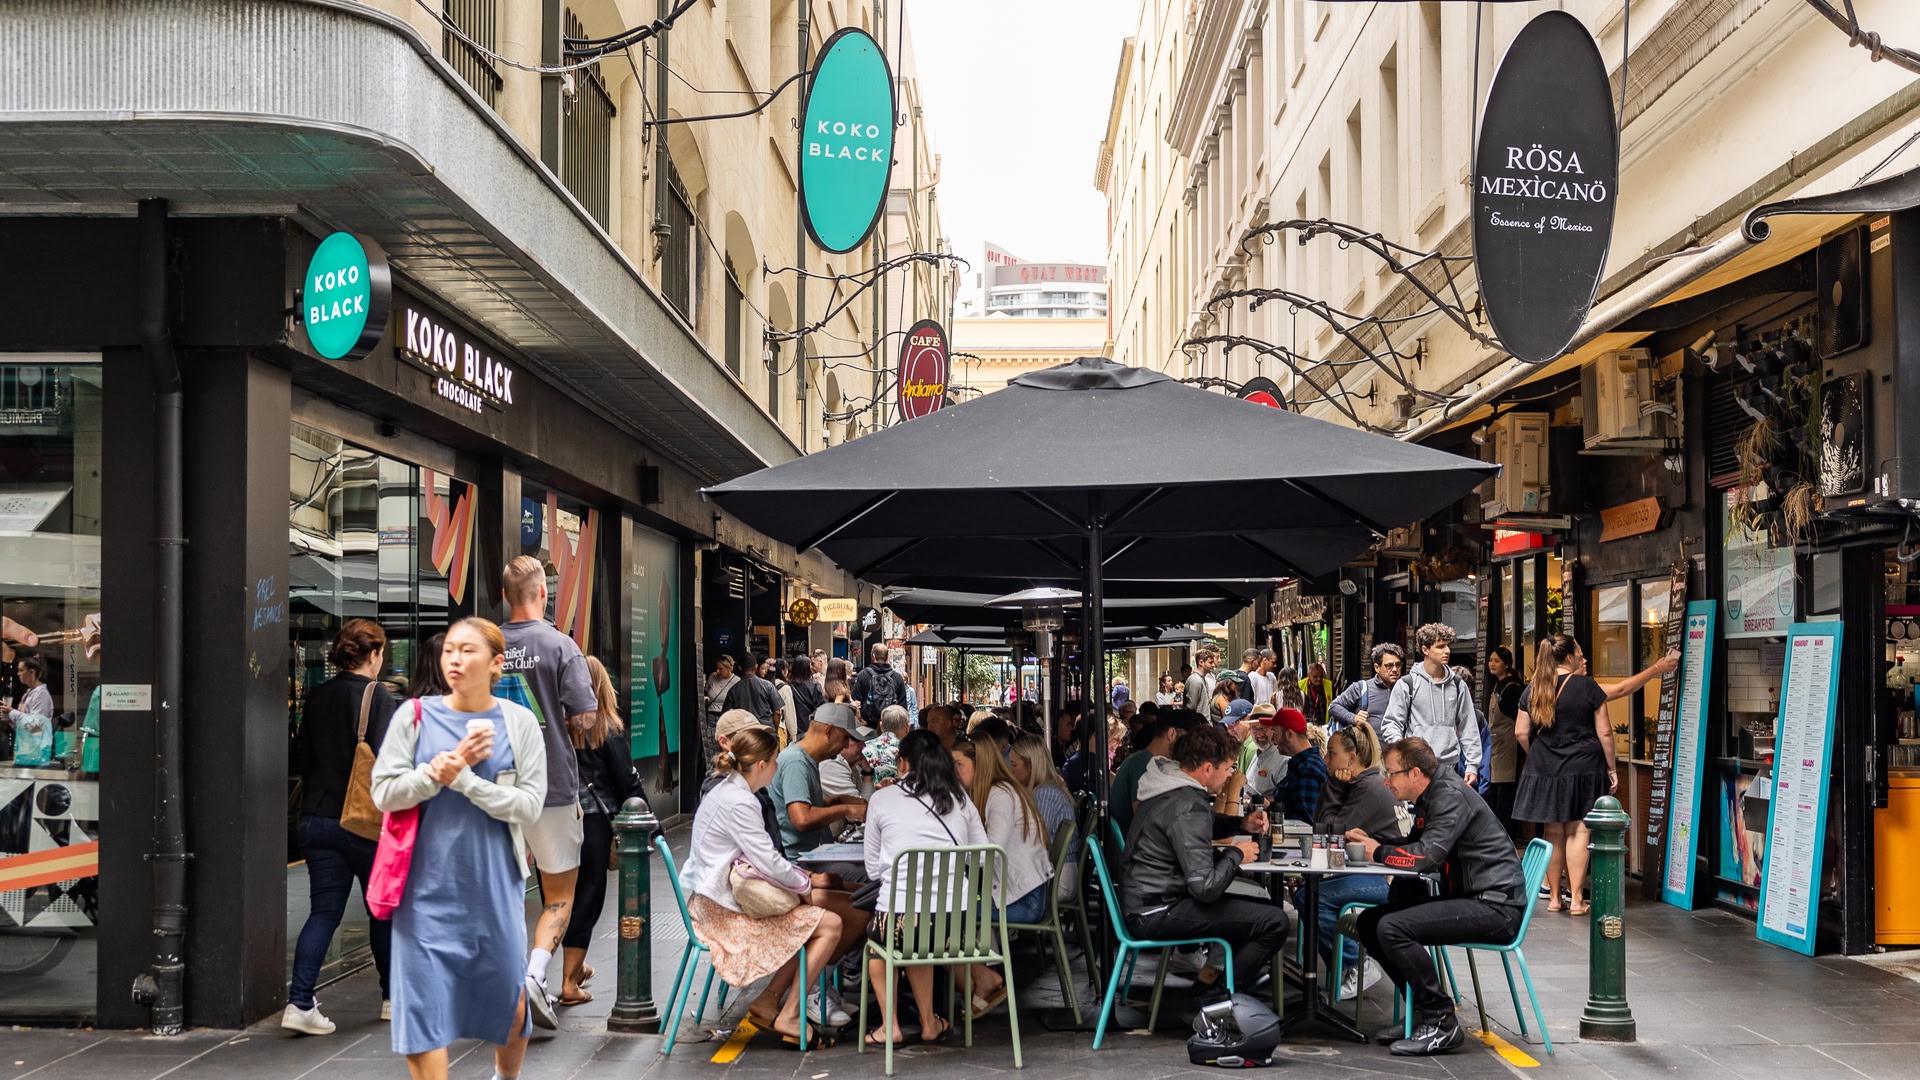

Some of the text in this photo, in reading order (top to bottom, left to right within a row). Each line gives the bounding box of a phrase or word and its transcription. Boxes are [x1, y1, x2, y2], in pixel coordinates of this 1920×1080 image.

[817, 120, 880, 139] KOKO
[809, 142, 884, 162] BLACK
[1505, 143, 1585, 175] RÖSA
[1480, 175, 1607, 203] MEXÌCANÖ
[1490, 211, 1593, 234] Essence of Mexico
[314, 265, 359, 293] KOKO
[1021, 267, 1097, 283] QUAY WEST
[310, 295, 364, 324] BLACK
[910, 333, 941, 347] CAFÉ
[406, 308, 513, 405] KOKO BLACK
[437, 377, 482, 414] CHOCOLATE
[902, 378, 944, 401] Andiamo
[633, 563, 645, 577] BLACK
[822, 602, 854, 613] PICCOLINA
[1744, 617, 1776, 632] BREAKFAST
[504, 646, 526, 659] tified
[1386, 856, 1414, 866] ARGON
